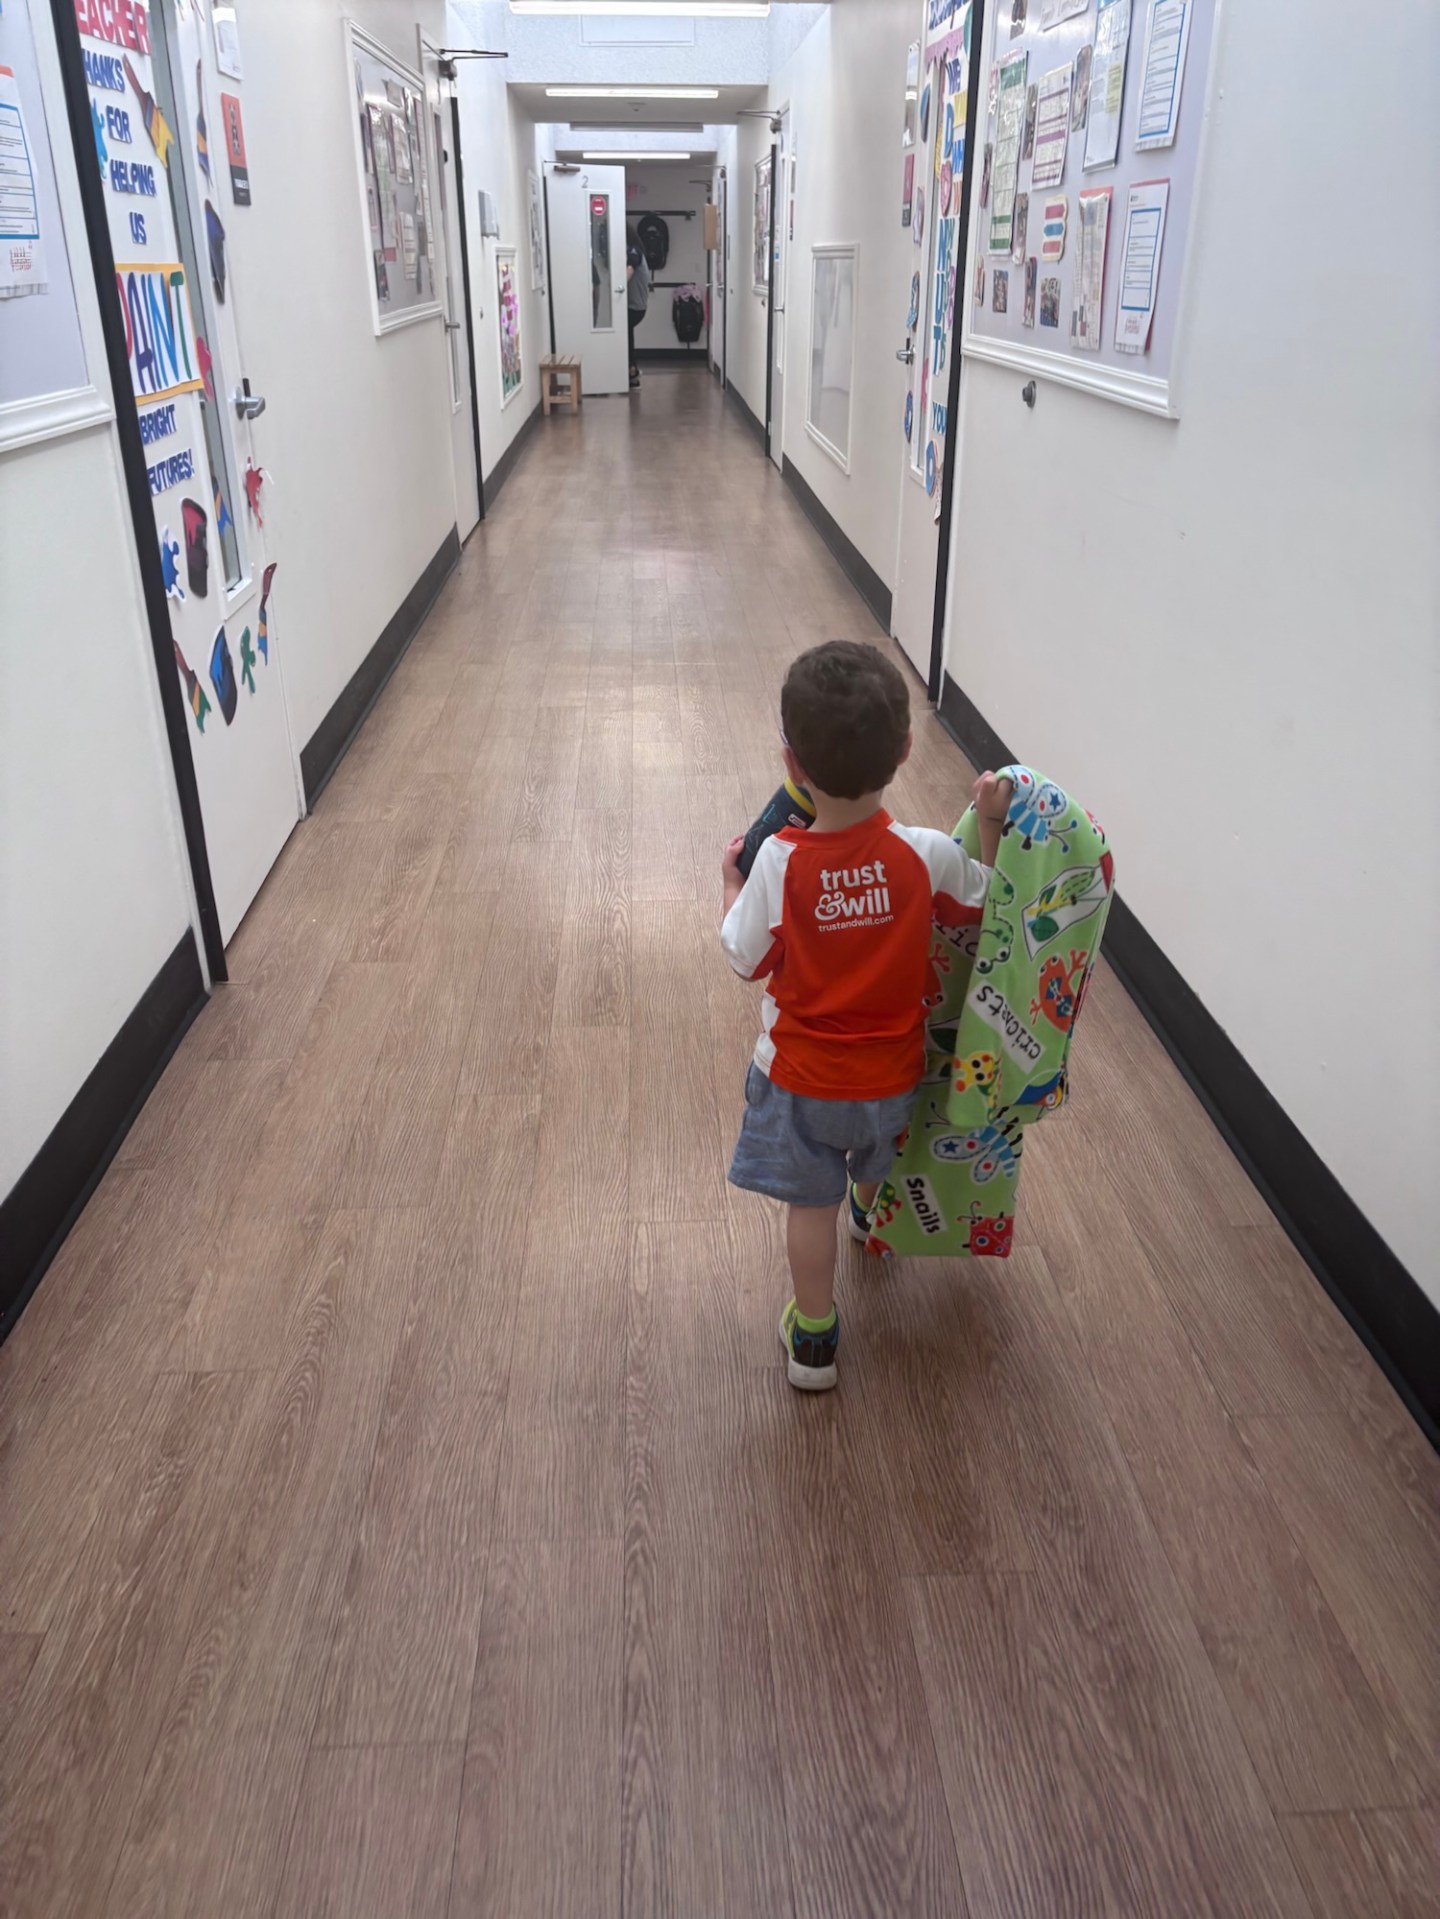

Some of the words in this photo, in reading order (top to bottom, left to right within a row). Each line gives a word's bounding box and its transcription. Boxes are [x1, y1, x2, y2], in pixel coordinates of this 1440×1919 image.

[75, 0, 152, 55] EACHER
[82, 48, 125, 93] HANKS
[106, 105, 132, 144] FOR
[110, 159, 157, 197] HELPING
[581, 175, 589, 189] 2
[129, 212, 147, 245] US
[140, 404, 177, 444] BRIGHT
[148, 449, 195, 496] FUTURES!
[820, 860, 888, 891] trust
[814, 887, 891, 921] &will
[818, 914, 895, 932] trustandwill.com
[906, 1177, 941, 1234] Snails
